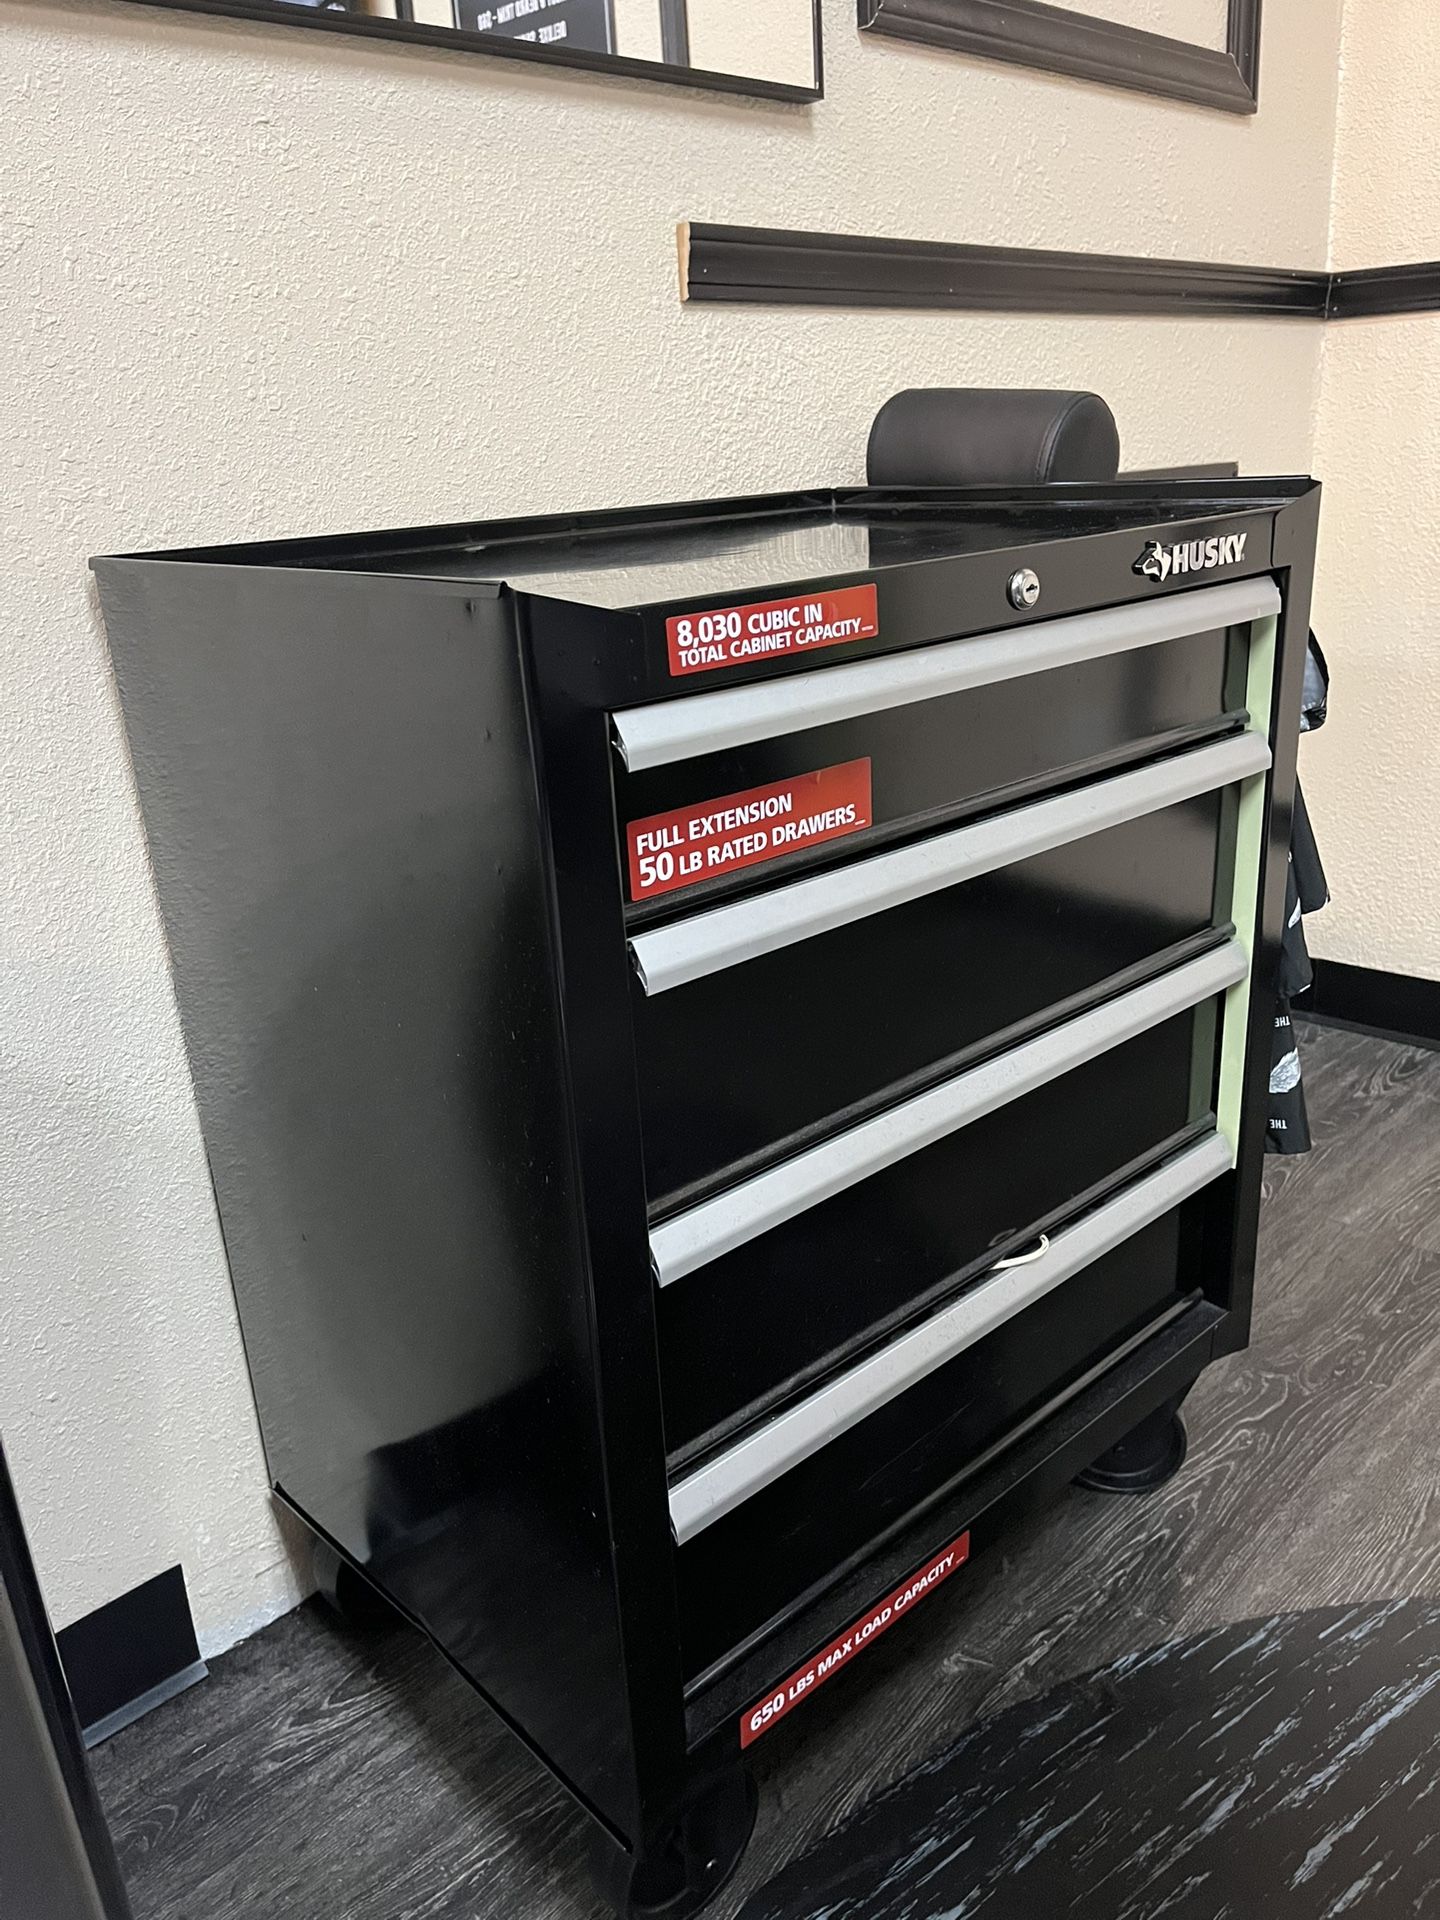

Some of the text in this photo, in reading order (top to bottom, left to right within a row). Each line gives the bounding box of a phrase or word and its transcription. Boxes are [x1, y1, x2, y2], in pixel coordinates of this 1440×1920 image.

[1172, 533, 1247, 574] HUSKY
[677, 603, 823, 647] 8,030 CUBIC IN
[678, 645, 728, 668] TOTAL
[730, 631, 793, 658] CABINET
[636, 792, 793, 856] FULL EXTENSION
[639, 851, 674, 888] 50
[679, 851, 703, 876] LB
[708, 831, 768, 867] RATED
[1274, 1015, 1291, 1028] THE
[1268, 1118, 1288, 1130] THE
[750, 1552, 955, 1732] 650 LBS MAX LOAD CAPACITY
